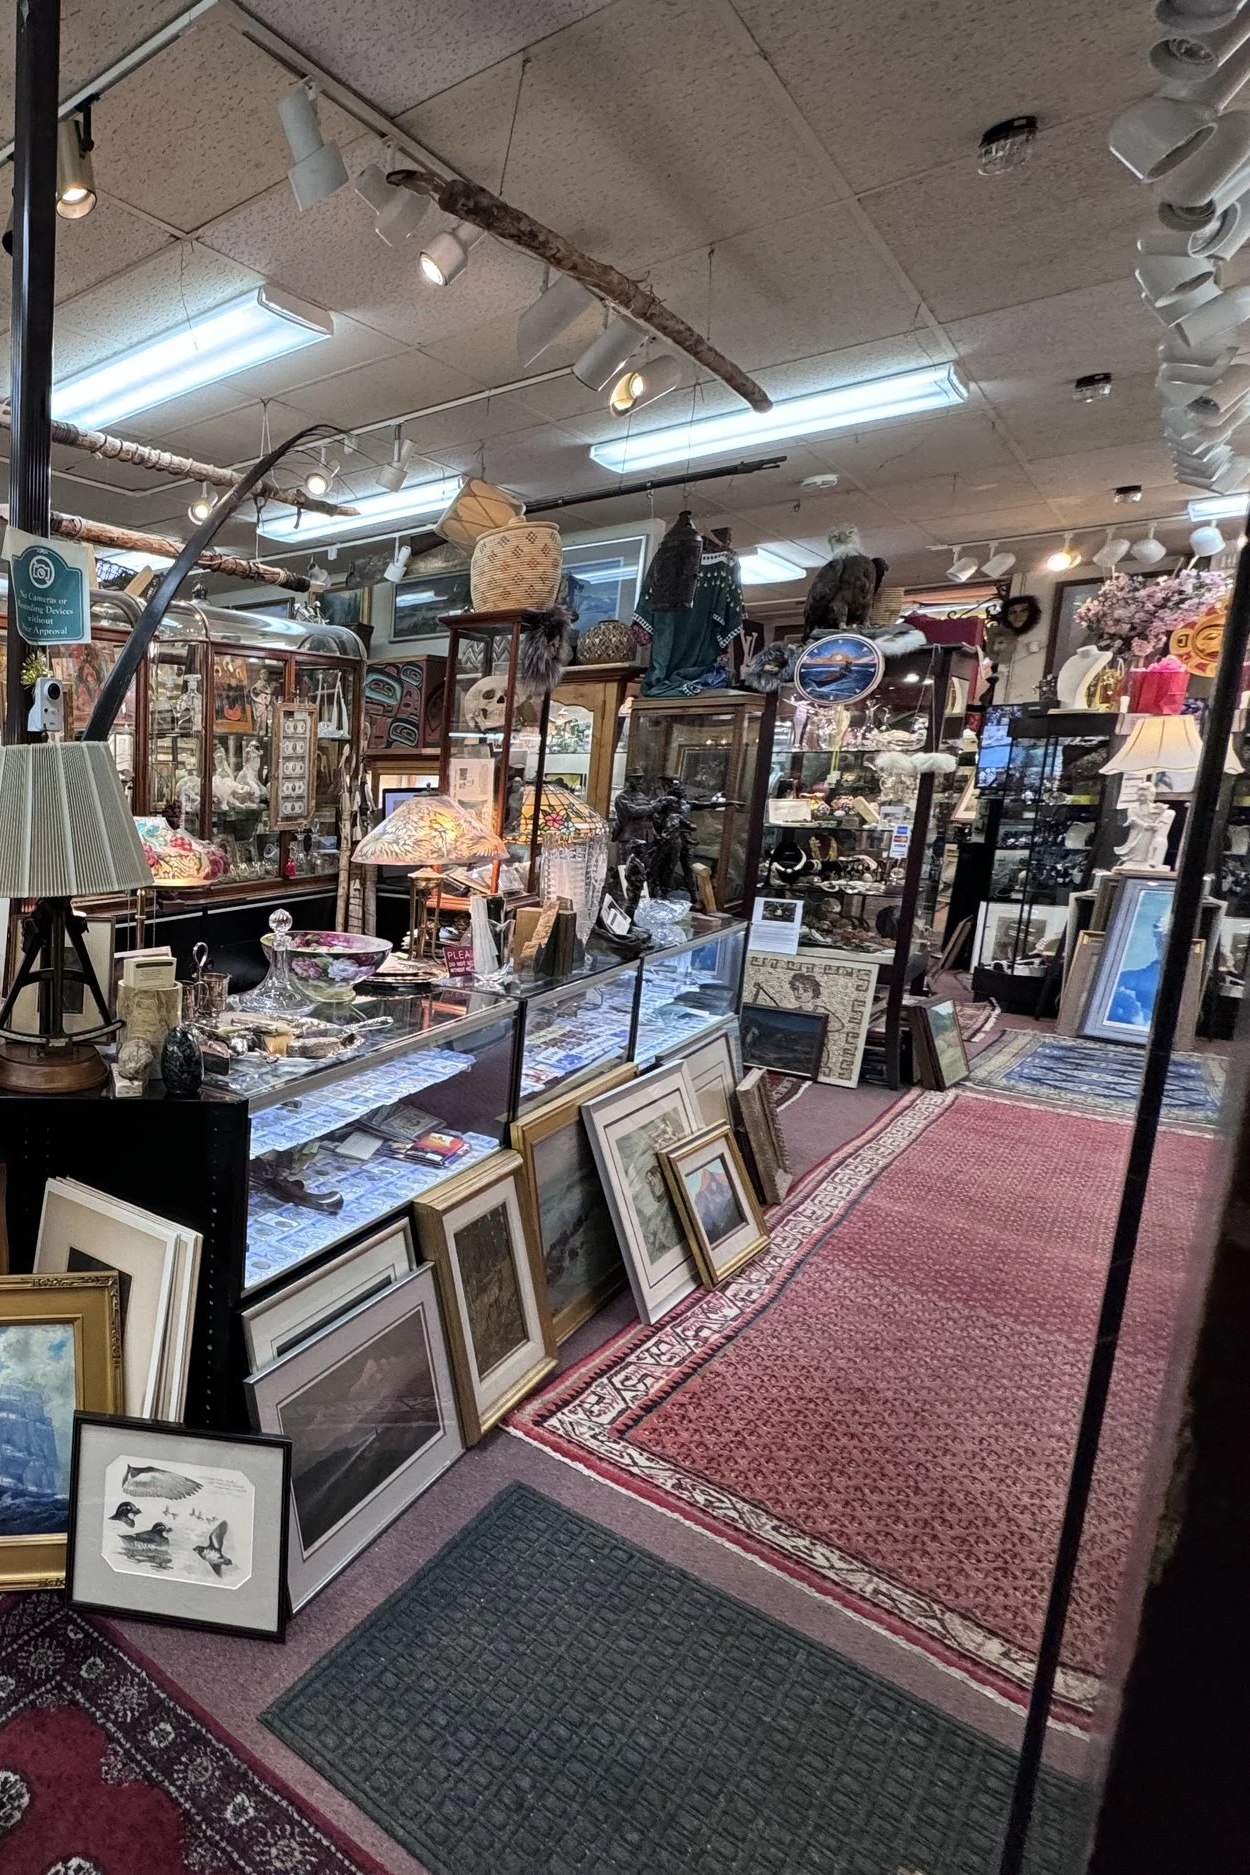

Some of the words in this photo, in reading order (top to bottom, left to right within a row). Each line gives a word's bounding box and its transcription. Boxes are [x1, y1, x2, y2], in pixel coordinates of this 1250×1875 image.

[19, 589, 27, 599] No
[28, 592, 57, 604] Cameras
[45, 605, 74, 615] Devices
[27, 614, 54, 625] without
[33, 625, 68, 636] Approval
[447, 950, 471, 960] PLEA
